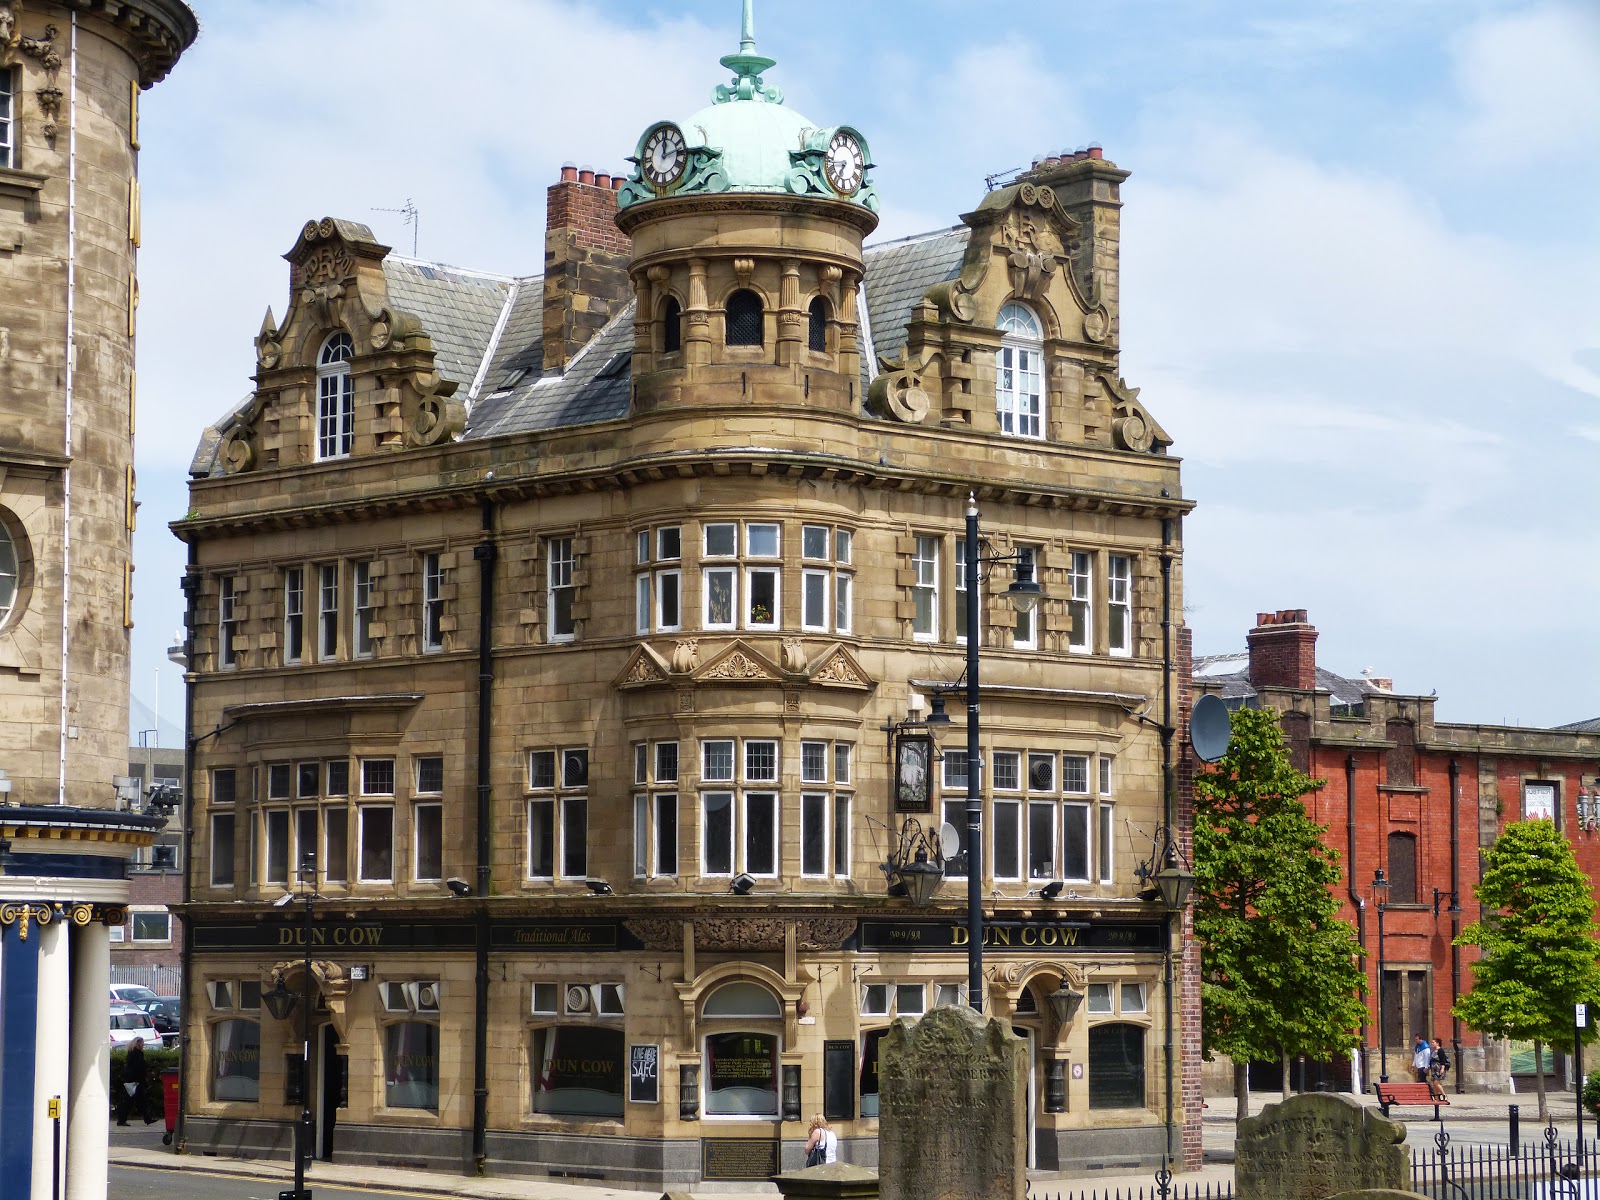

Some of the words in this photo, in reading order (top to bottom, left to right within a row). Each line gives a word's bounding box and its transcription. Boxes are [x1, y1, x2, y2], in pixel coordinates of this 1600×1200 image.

[278, 927, 327, 945] DUN
[333, 927, 384, 945] COW
[514, 927, 569, 943] Traditional
[568, 927, 591, 944] Ales
[950, 926, 1011, 946] DUN
[1020, 926, 1080, 946] COW
[545, 1058, 578, 1072] DUN
[581, 1059, 615, 1073] COW
